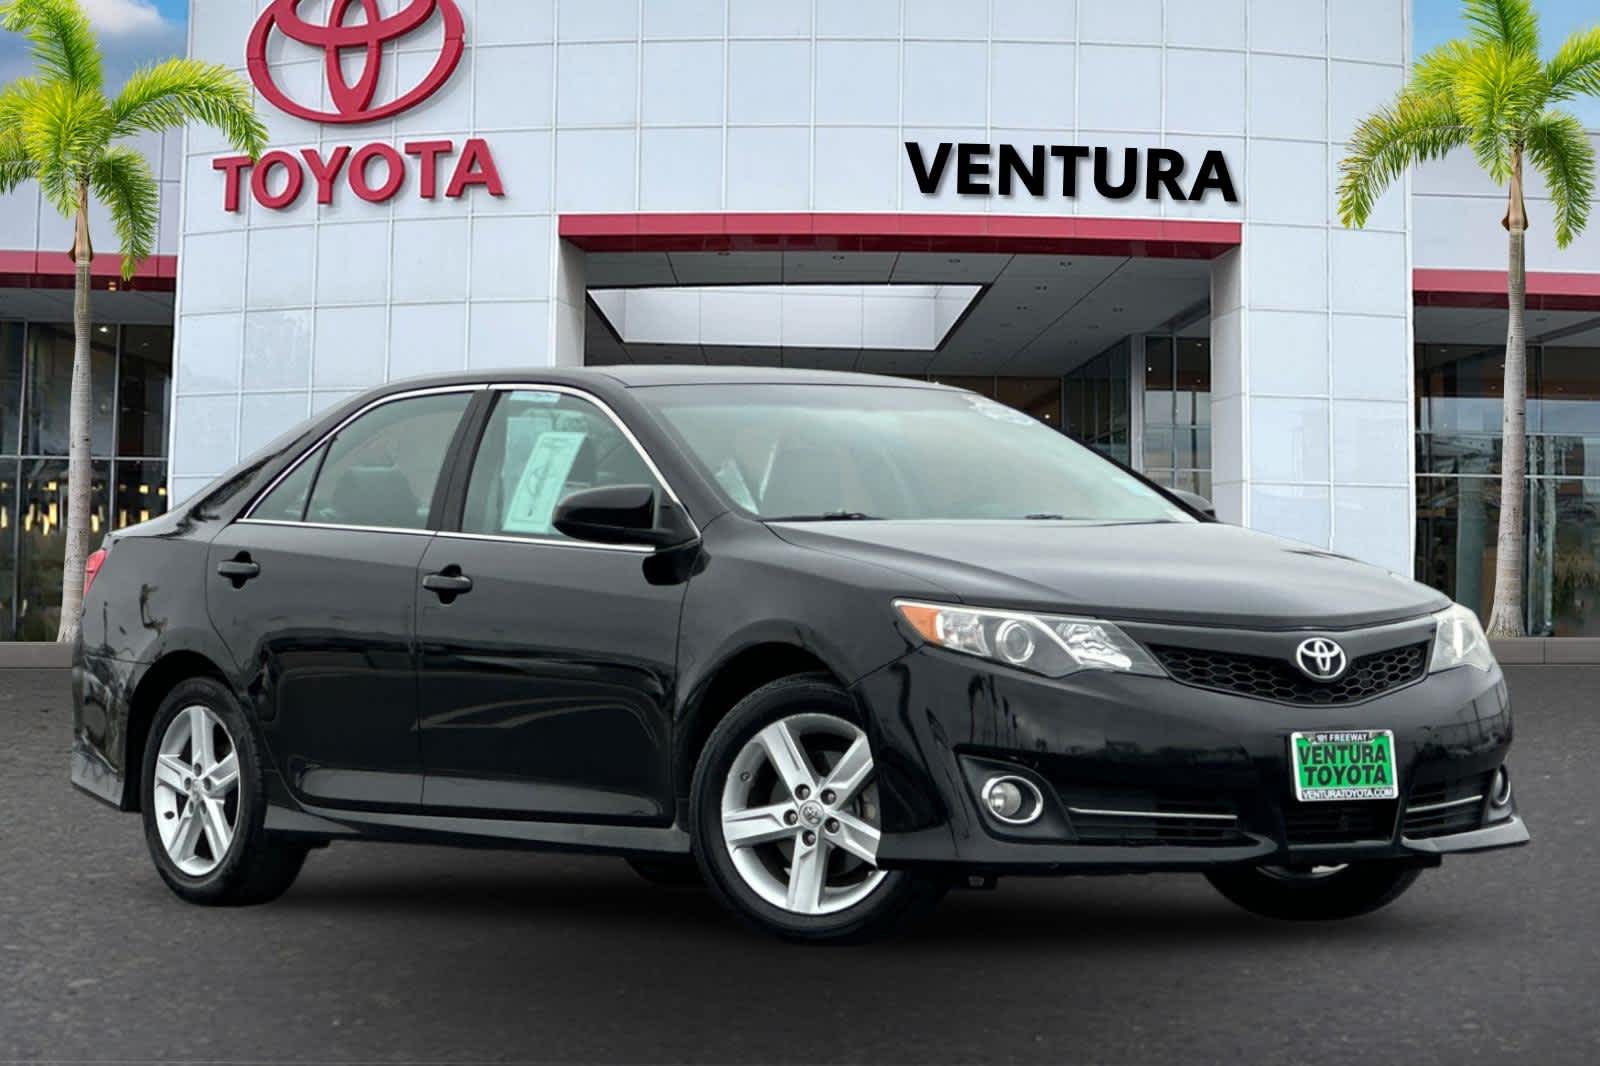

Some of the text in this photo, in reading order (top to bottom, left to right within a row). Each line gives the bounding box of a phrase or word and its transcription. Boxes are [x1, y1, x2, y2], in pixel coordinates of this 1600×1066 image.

[212, 138, 505, 212] TOYOTA
[904, 142, 1239, 203] VENTURA
[1329, 733, 1368, 742] FREEWAY
[1299, 744, 1387, 764] VENTURA
[1304, 764, 1387, 786] TOYOTA
[1302, 788, 1394, 800] VENTURATOYOTA.COM
